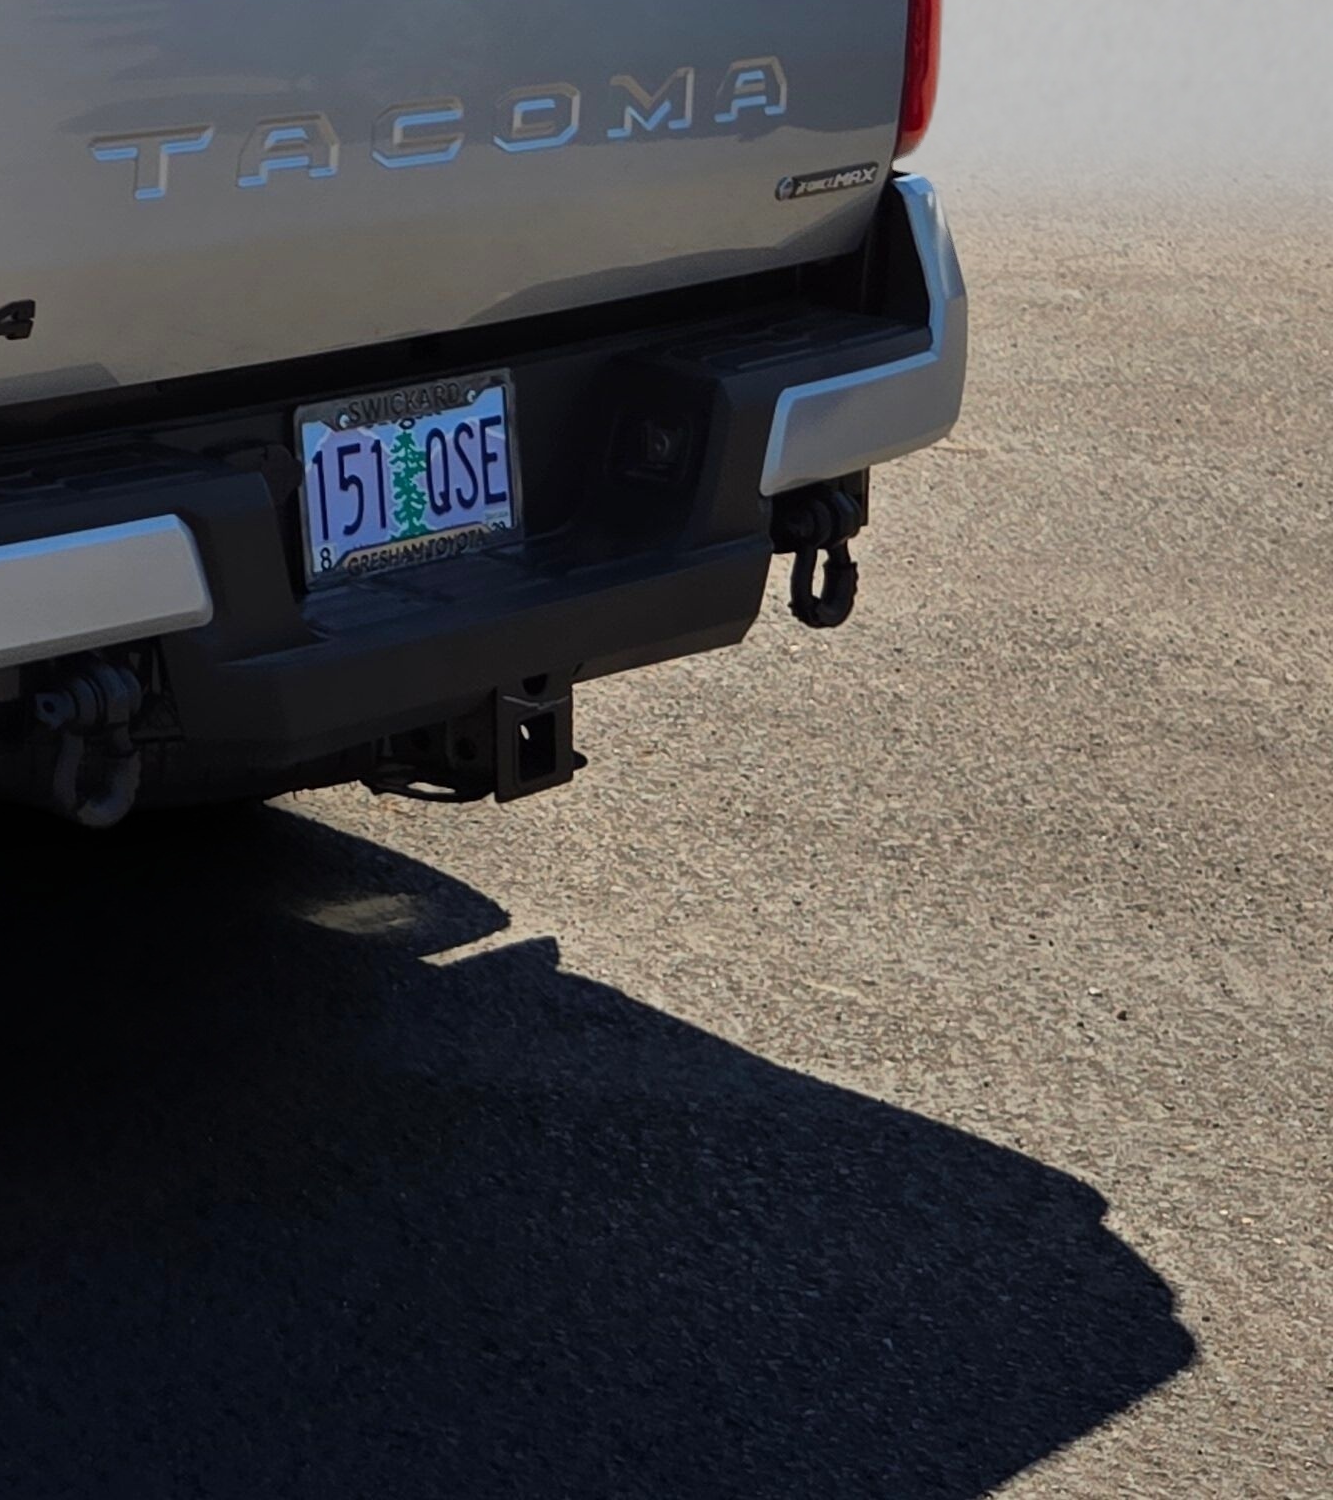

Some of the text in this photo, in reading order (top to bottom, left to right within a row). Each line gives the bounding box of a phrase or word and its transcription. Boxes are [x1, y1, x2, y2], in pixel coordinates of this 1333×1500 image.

[89, 56, 788, 199] TACOMA
[349, 382, 460, 421] SWICKARD
[312, 415, 508, 541] 151 QSE
[319, 547, 332, 571] 8
[347, 528, 487, 577] GRESHAM TOYOTA
